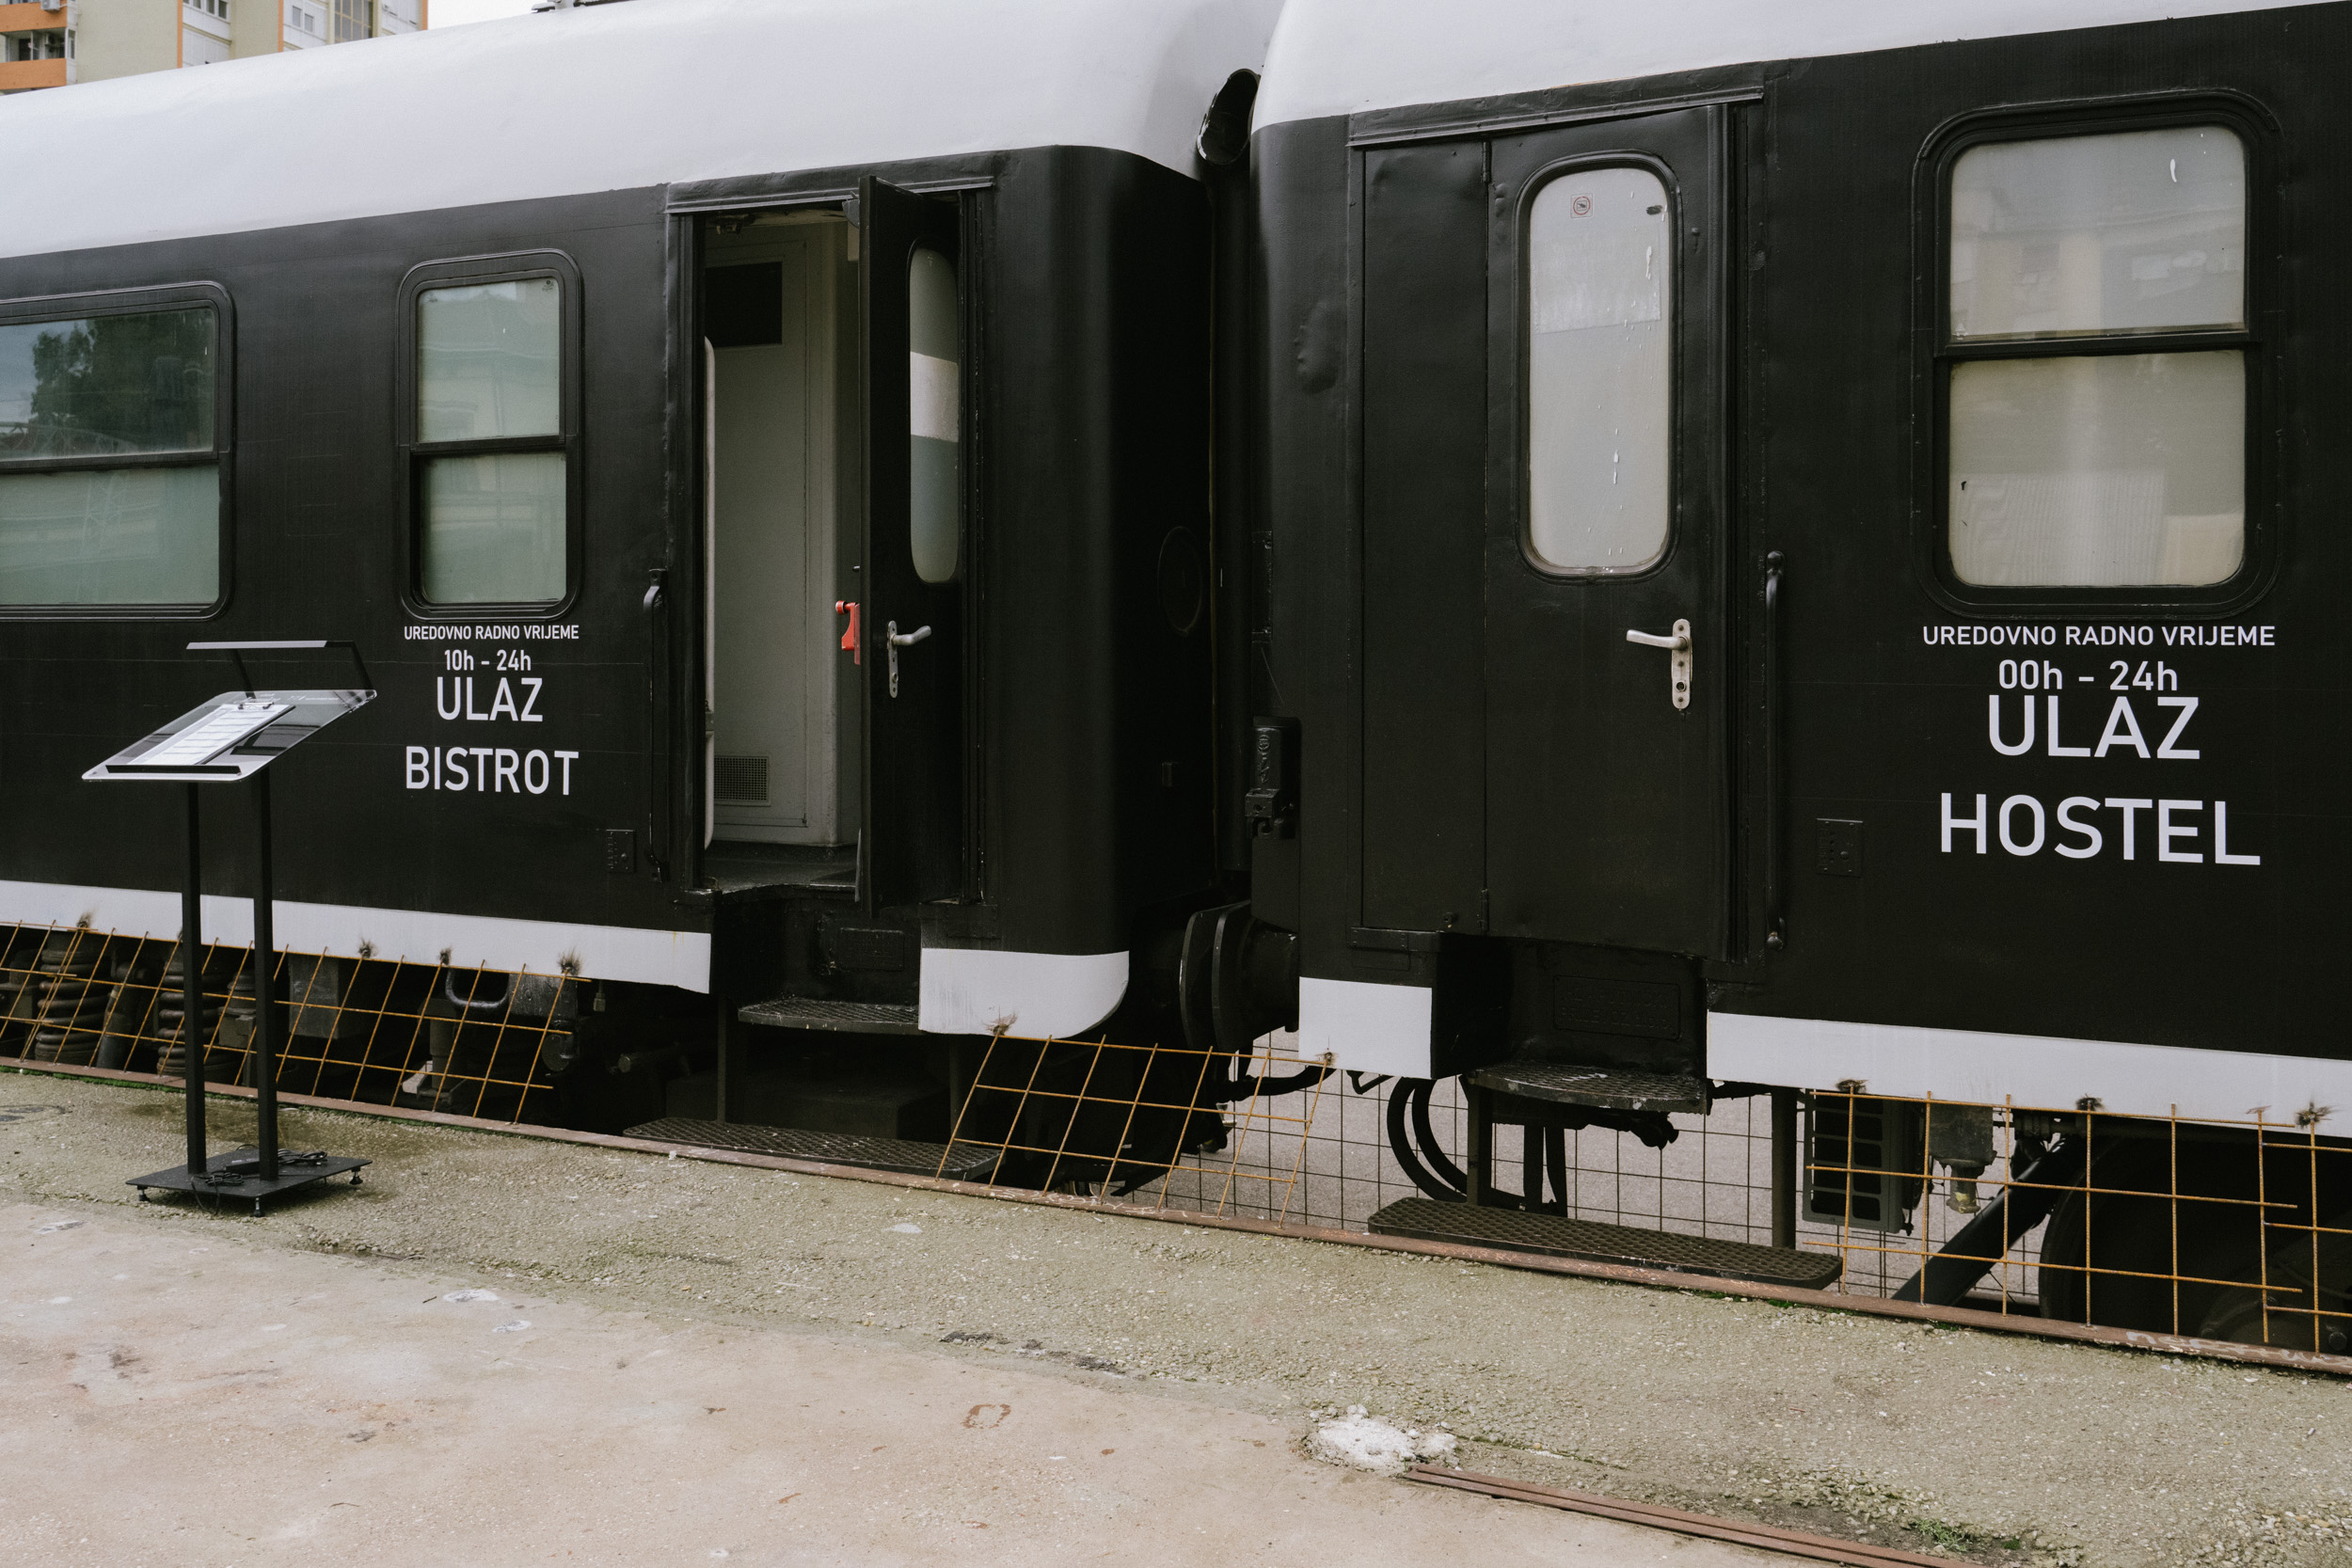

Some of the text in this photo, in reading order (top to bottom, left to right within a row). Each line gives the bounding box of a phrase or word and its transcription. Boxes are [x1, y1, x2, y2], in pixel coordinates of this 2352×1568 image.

[404, 625, 580, 641] UREDOVNO RADNO VRIJEME
[1923, 626, 2276, 646] UREDOVNO RADNO VRIJEME
[444, 649, 474, 672] 10h
[496, 649, 532, 672] 24h
[1998, 658, 2063, 690] 00h
[2109, 659, 2178, 691] 24h
[437, 676, 544, 722] ULAZ
[1989, 694, 2201, 760] ULAZ
[405, 745, 580, 796] BISTROT
[1941, 792, 2261, 865] HOSTEL
